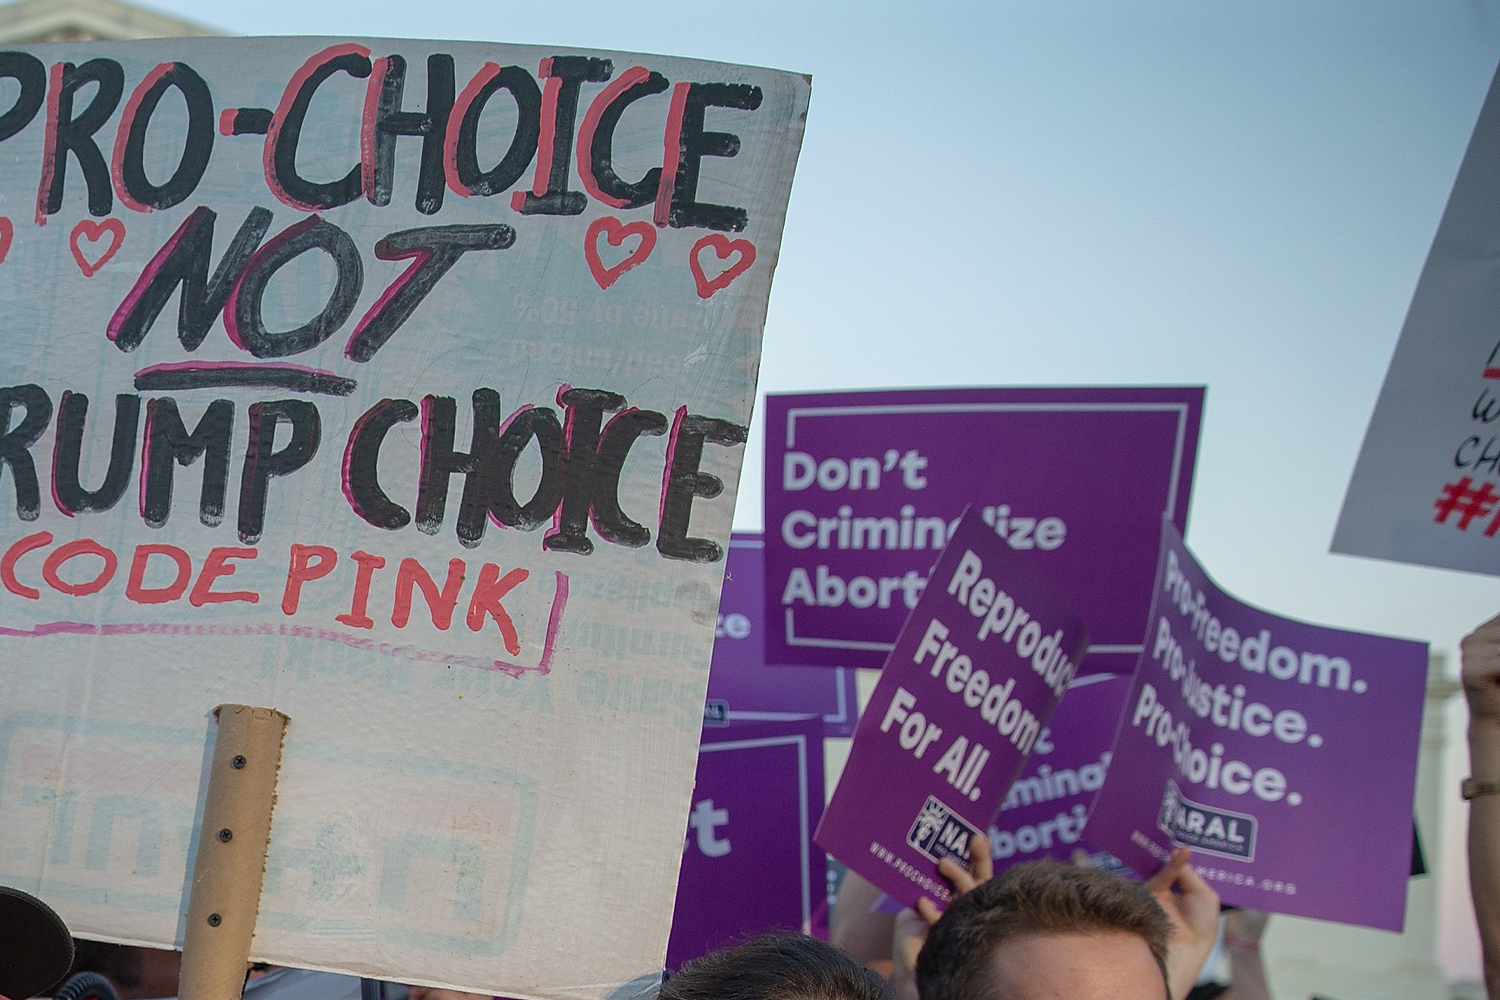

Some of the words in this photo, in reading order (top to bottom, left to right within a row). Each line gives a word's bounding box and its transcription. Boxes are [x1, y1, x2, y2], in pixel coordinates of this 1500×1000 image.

[105, 205, 517, 363] NOT
[341, 382, 750, 564] CHOICE
[782, 448, 929, 491] Don’t
[0, 531, 260, 609] CODE
[281, 543, 530, 656] PINK
[780, 564, 930, 610] Abort
[879, 686, 943, 760] For
[932, 734, 982, 803] All.
